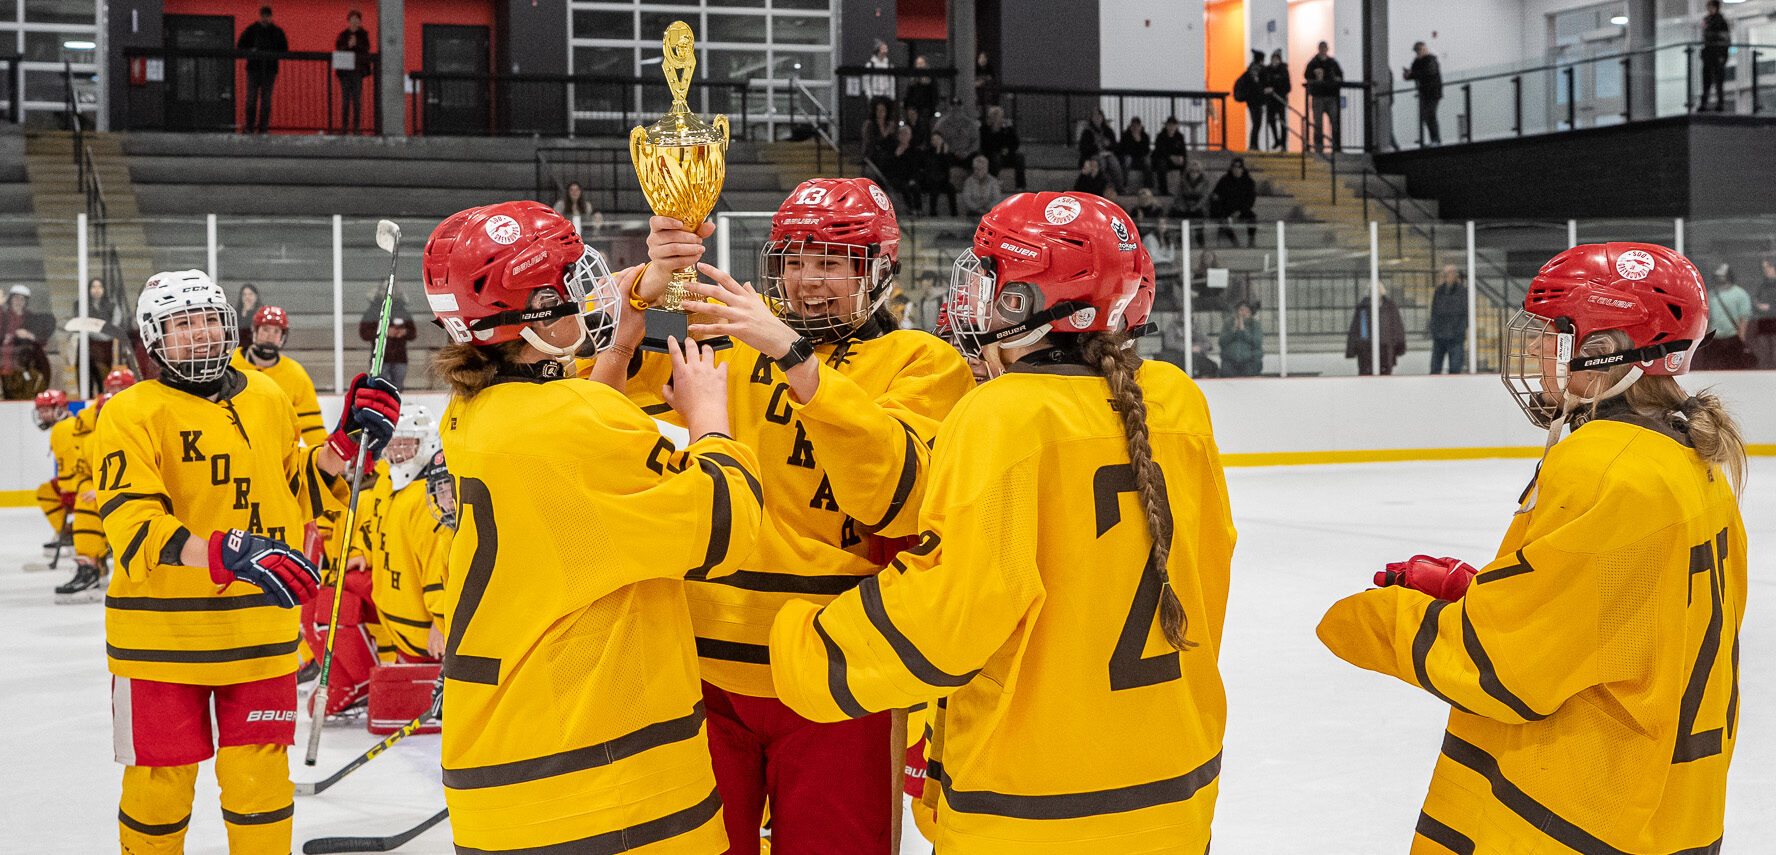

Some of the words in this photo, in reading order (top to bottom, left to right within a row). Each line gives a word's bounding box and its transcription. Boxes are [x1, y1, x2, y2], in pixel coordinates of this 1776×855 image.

[795, 187, 827, 205] 13
[1000, 242, 1038, 259] BAUER
[512, 250, 548, 276] BAUER
[996, 324, 1027, 338] BAUER
[1584, 355, 1624, 367] BAUER
[99, 450, 132, 491] 12
[1093, 462, 1183, 691] 2
[366, 718, 421, 760] CCM
